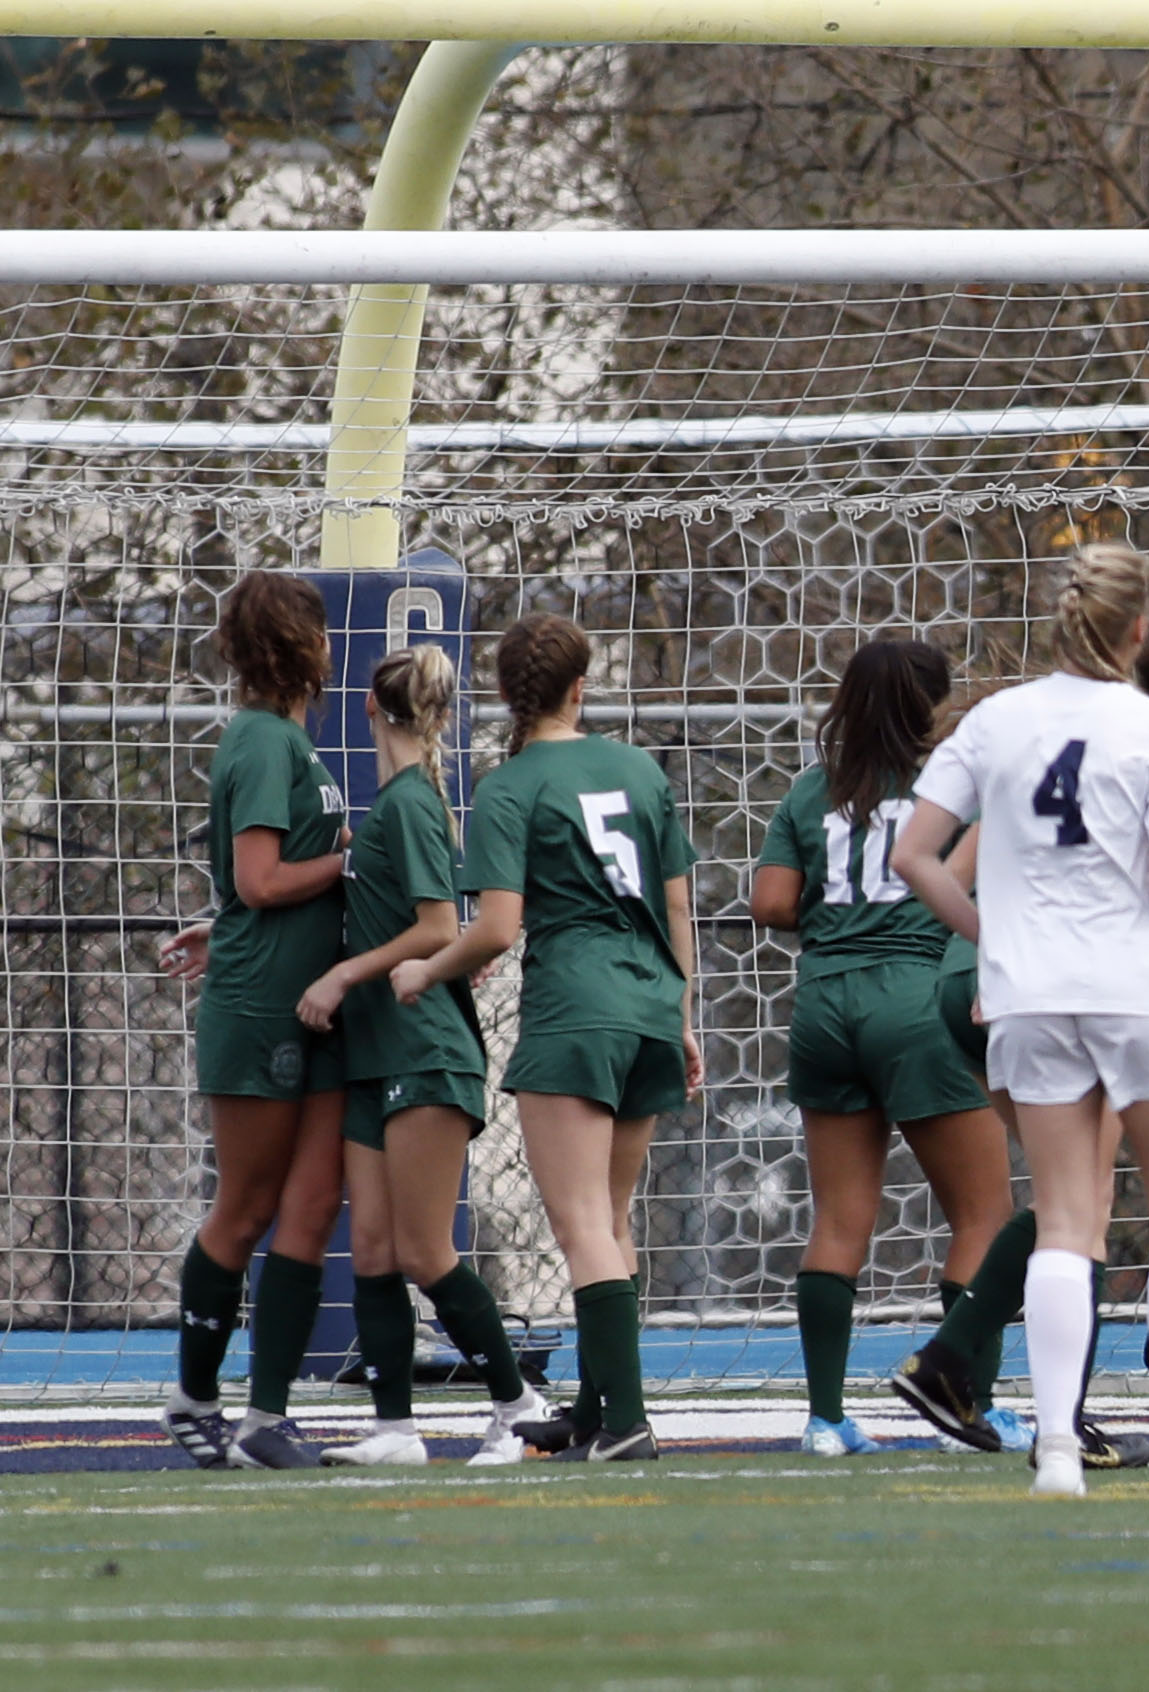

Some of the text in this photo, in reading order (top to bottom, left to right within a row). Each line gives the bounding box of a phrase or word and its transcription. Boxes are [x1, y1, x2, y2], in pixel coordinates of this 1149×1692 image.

[578, 791, 642, 898] 5
[1032, 739, 1088, 845] 4
[823, 799, 914, 904] 10
